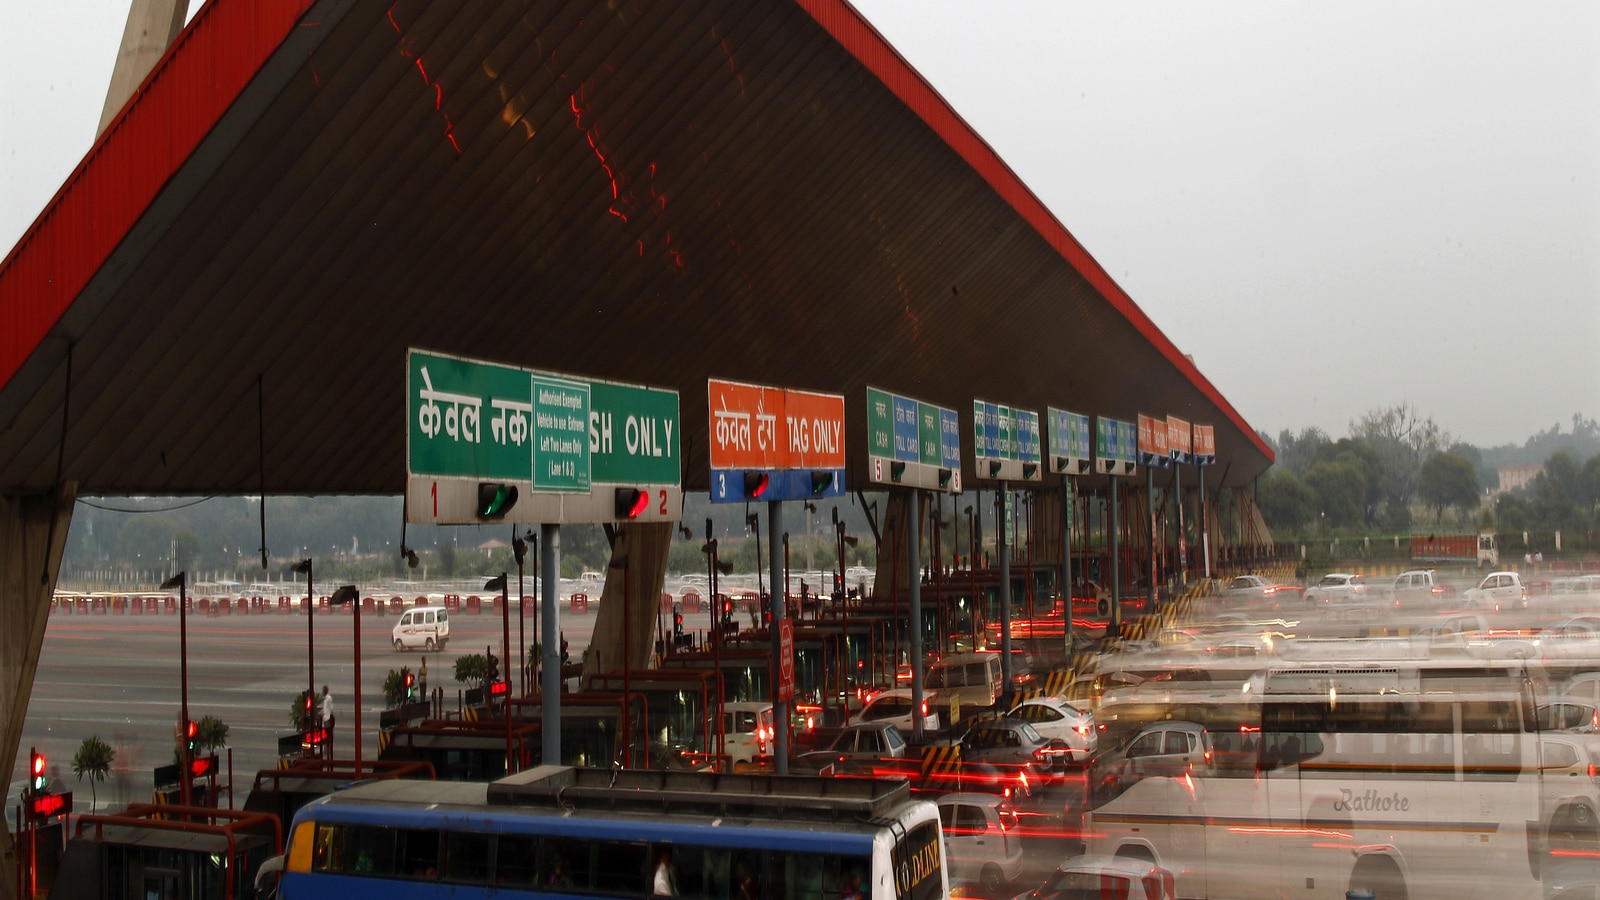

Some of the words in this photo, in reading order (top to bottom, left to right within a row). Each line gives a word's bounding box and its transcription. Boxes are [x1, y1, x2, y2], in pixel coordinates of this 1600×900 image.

[419, 366, 482, 443] केवल
[491, 399, 532, 446] नक
[539, 388, 561, 406] Authorised
[563, 392, 582, 411] Exempted
[537, 411, 553, 429] Vehicle
[554, 414, 558, 430] to
[568, 415, 584, 432] Extreme
[714, 393, 751, 452] केवल
[540, 435, 550, 452] Left
[550, 436, 559, 452] Two
[560, 437, 572, 454] Lanes
[572, 439, 582, 458] Only
[625, 415, 673, 457] ONLY
[786, 416, 809, 453] TAG
[813, 418, 840, 454] ONLY
[875, 430, 888, 448] CASH
[896, 435, 905, 451] TOLL
[907, 436, 917, 454] CARD
[924, 441, 935, 457] CASH
[876, 459, 881, 480] 5
[719, 474, 726, 498] 3
[431, 481, 438, 518] 1
[659, 490, 668, 515] 2
[1333, 788, 1410, 812] Rathore
